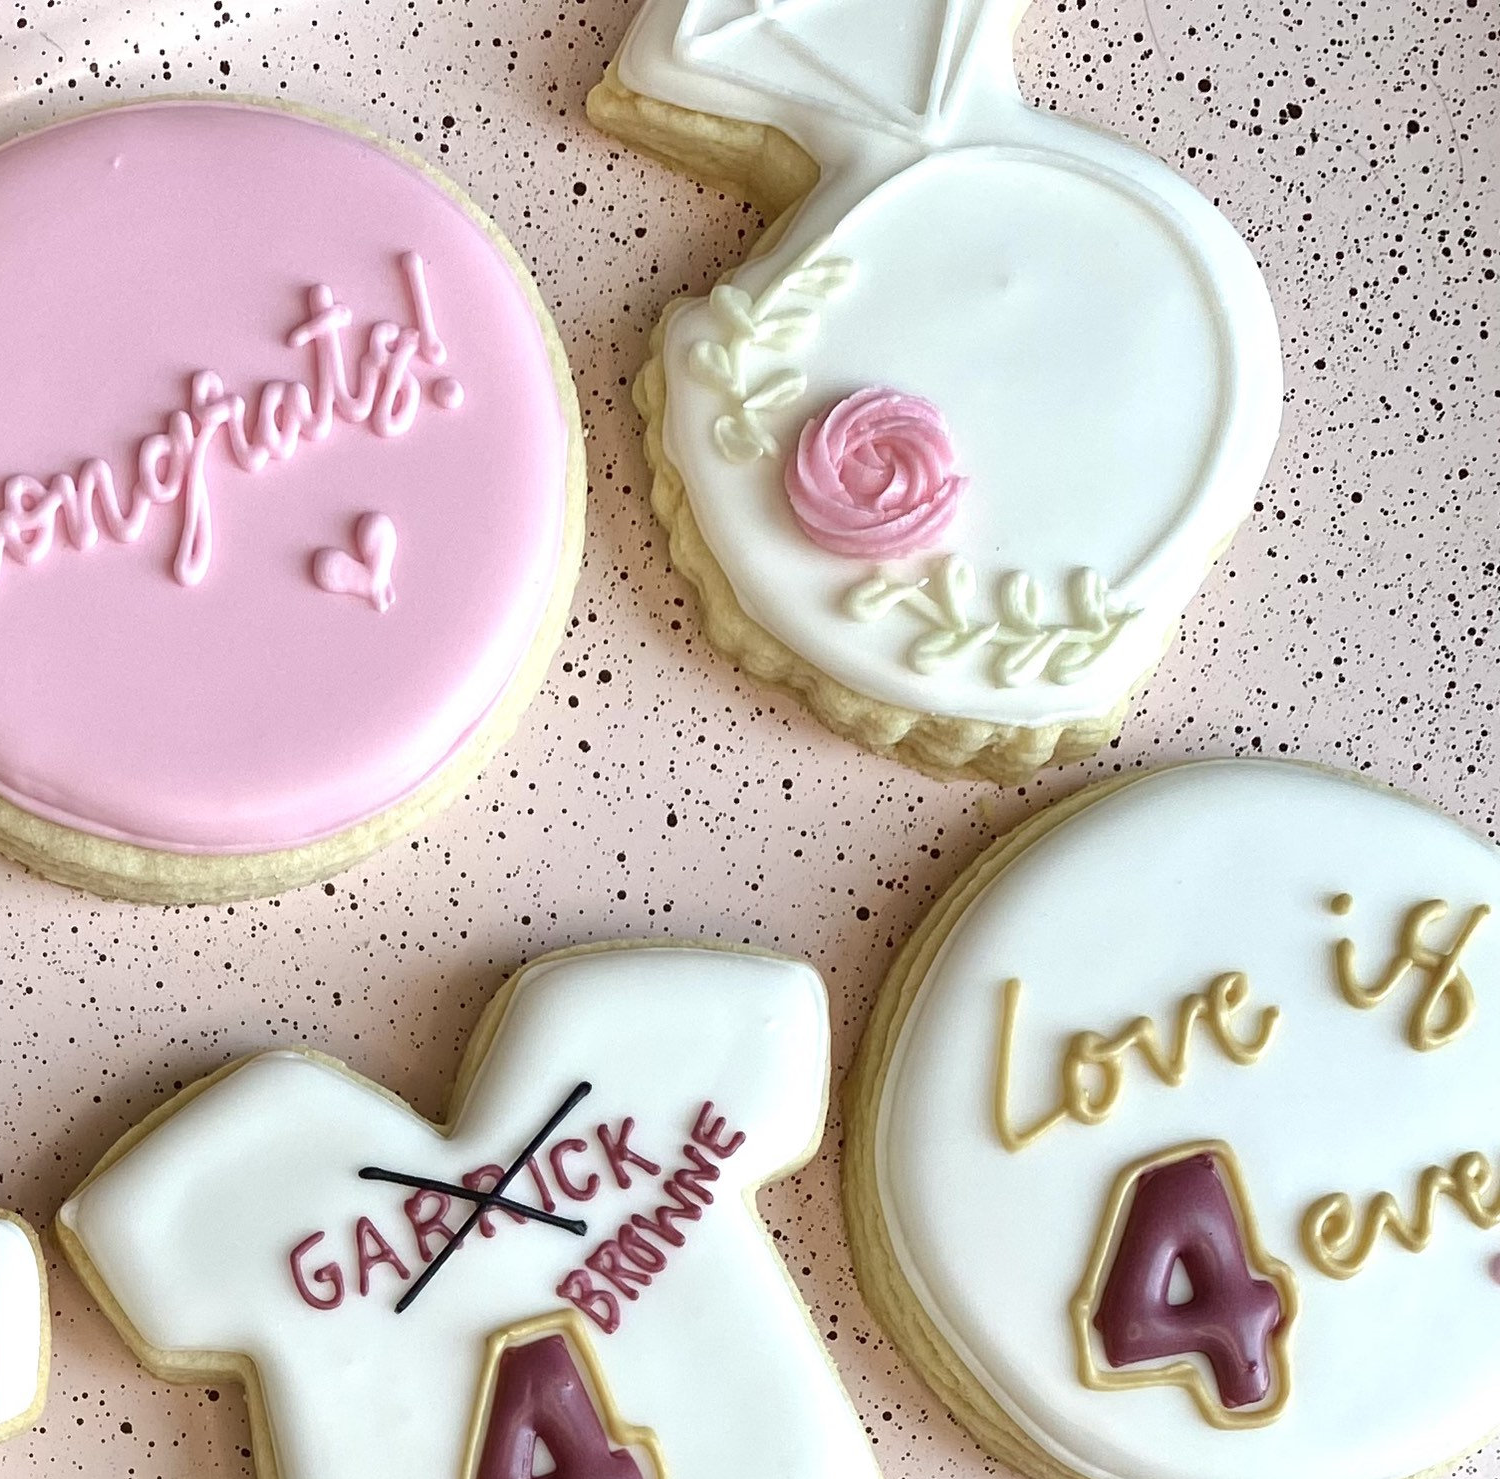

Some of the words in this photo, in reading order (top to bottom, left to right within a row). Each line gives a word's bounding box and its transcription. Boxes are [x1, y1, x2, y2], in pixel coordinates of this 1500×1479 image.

[1332, 892, 1492, 1051] is
[289, 1117, 661, 1310] GARRICK
[556, 1100, 746, 1334] BROWNE
[1081, 1143, 1290, 1421] 4
[1301, 1151, 1500, 1281] eve
